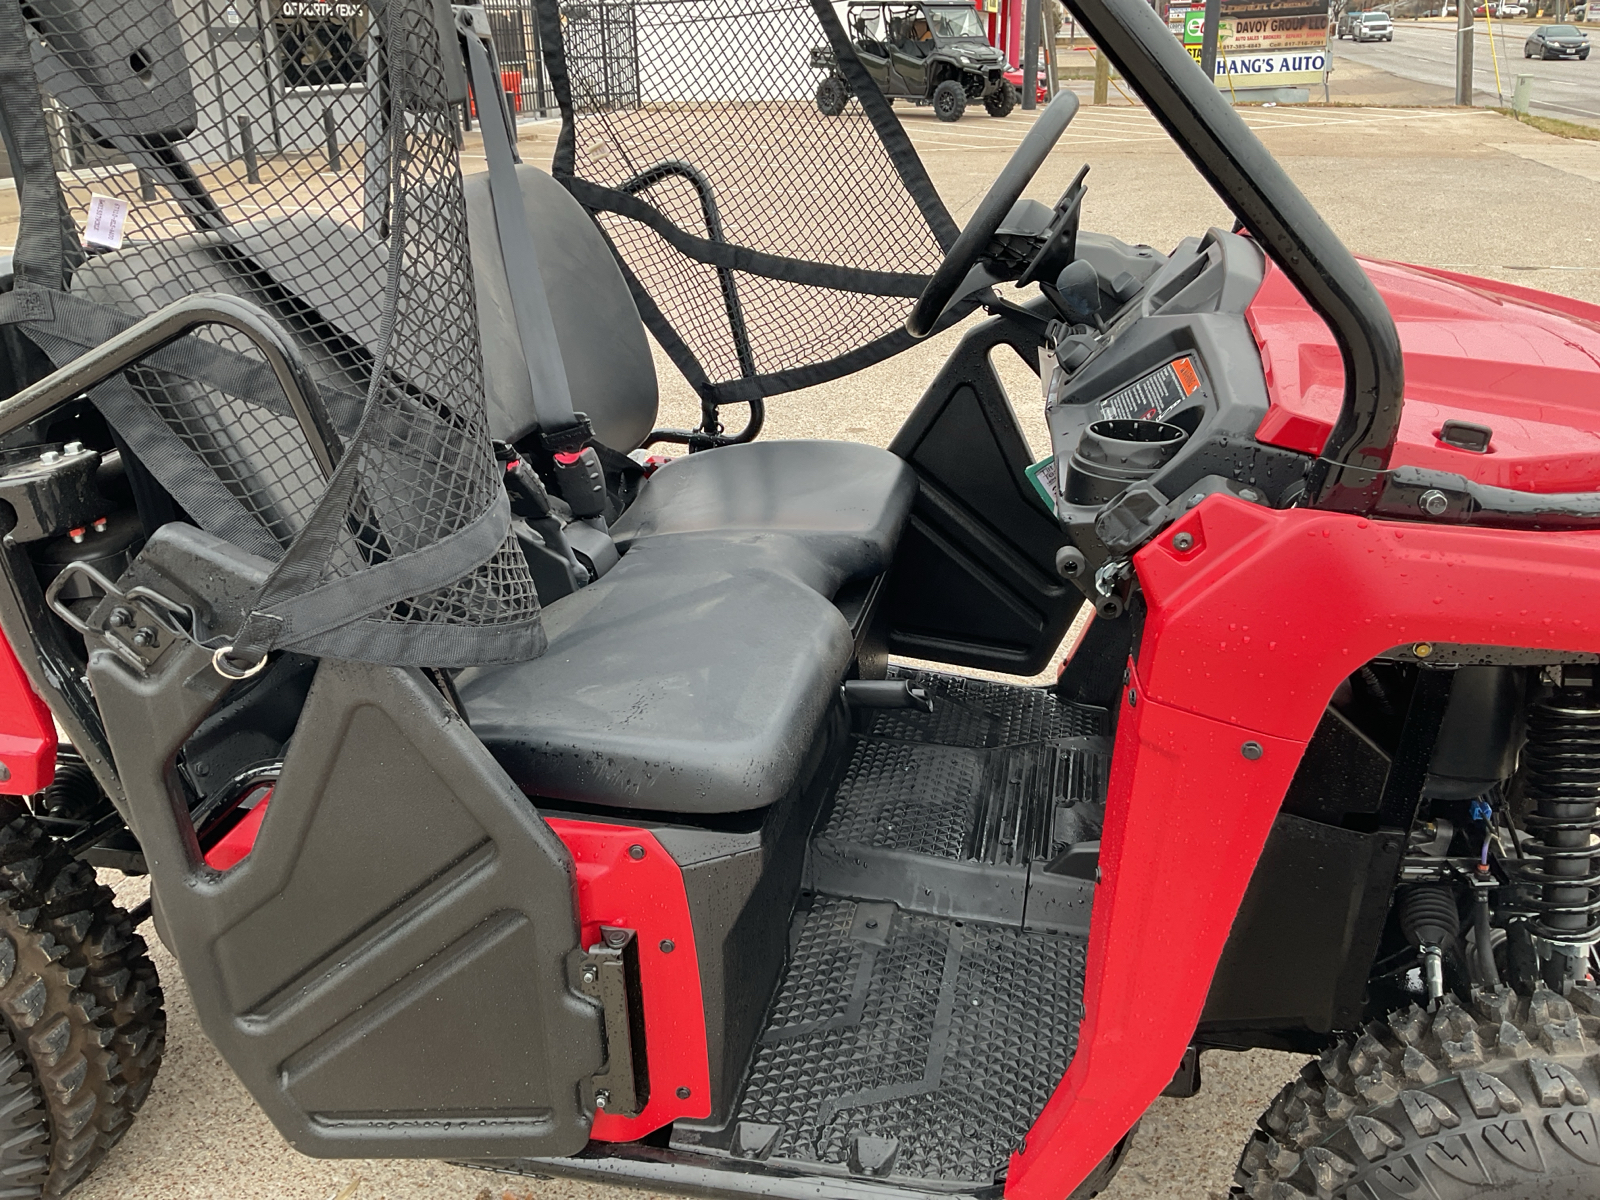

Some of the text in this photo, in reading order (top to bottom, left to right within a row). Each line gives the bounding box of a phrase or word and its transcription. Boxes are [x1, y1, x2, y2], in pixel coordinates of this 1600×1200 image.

[1236, 15, 1326, 33] DAVOY GROUP LLC
[1216, 56, 1325, 74] HANG'S AUTO
